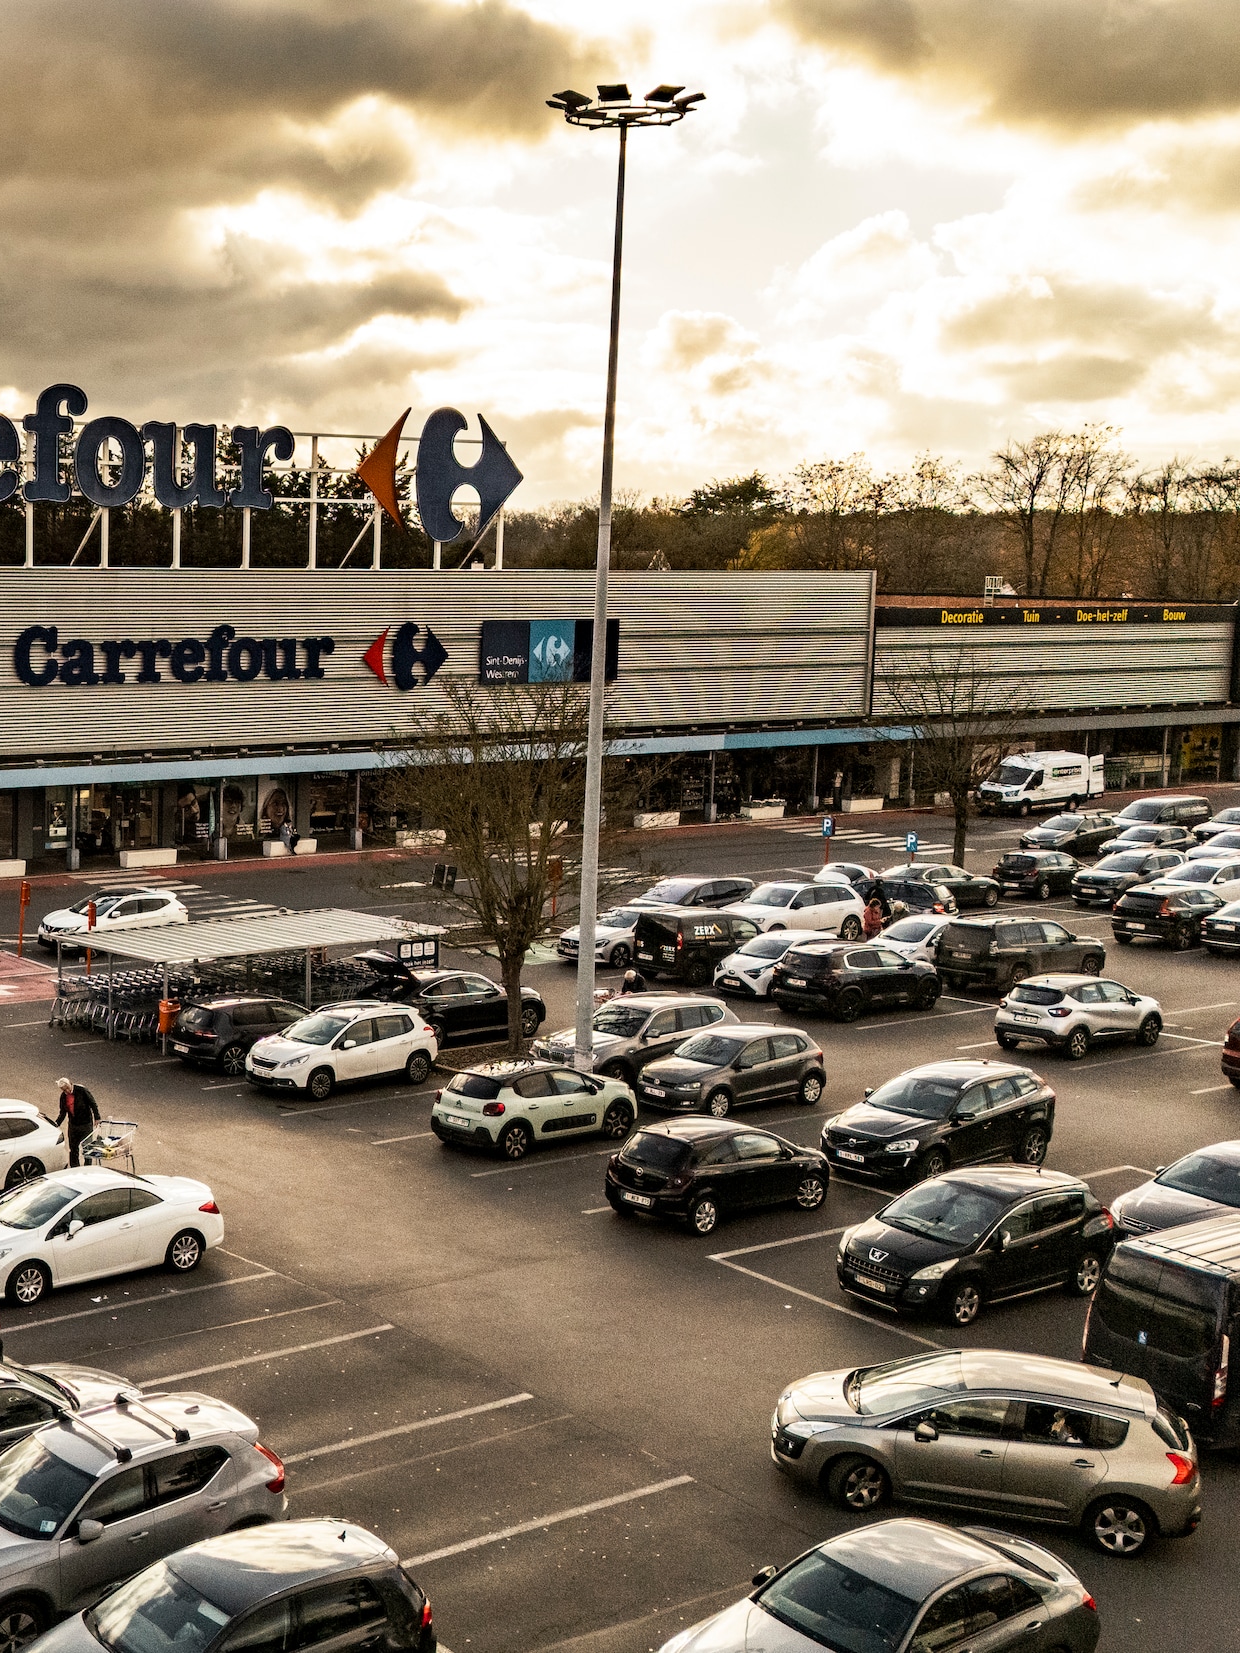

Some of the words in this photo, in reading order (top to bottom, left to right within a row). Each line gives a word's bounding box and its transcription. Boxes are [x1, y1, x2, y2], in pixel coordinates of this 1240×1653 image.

[941, 609, 984, 624] Decoratie
[1023, 610, 1040, 623] Tuin
[1076, 609, 1129, 622] Doe-het-zelf
[1163, 608, 1186, 621] Bouw
[13, 623, 336, 687] Carrefour
[823, 819, 831, 832] P
[907, 834, 915, 847] P
[694, 925, 716, 936] ZERX
